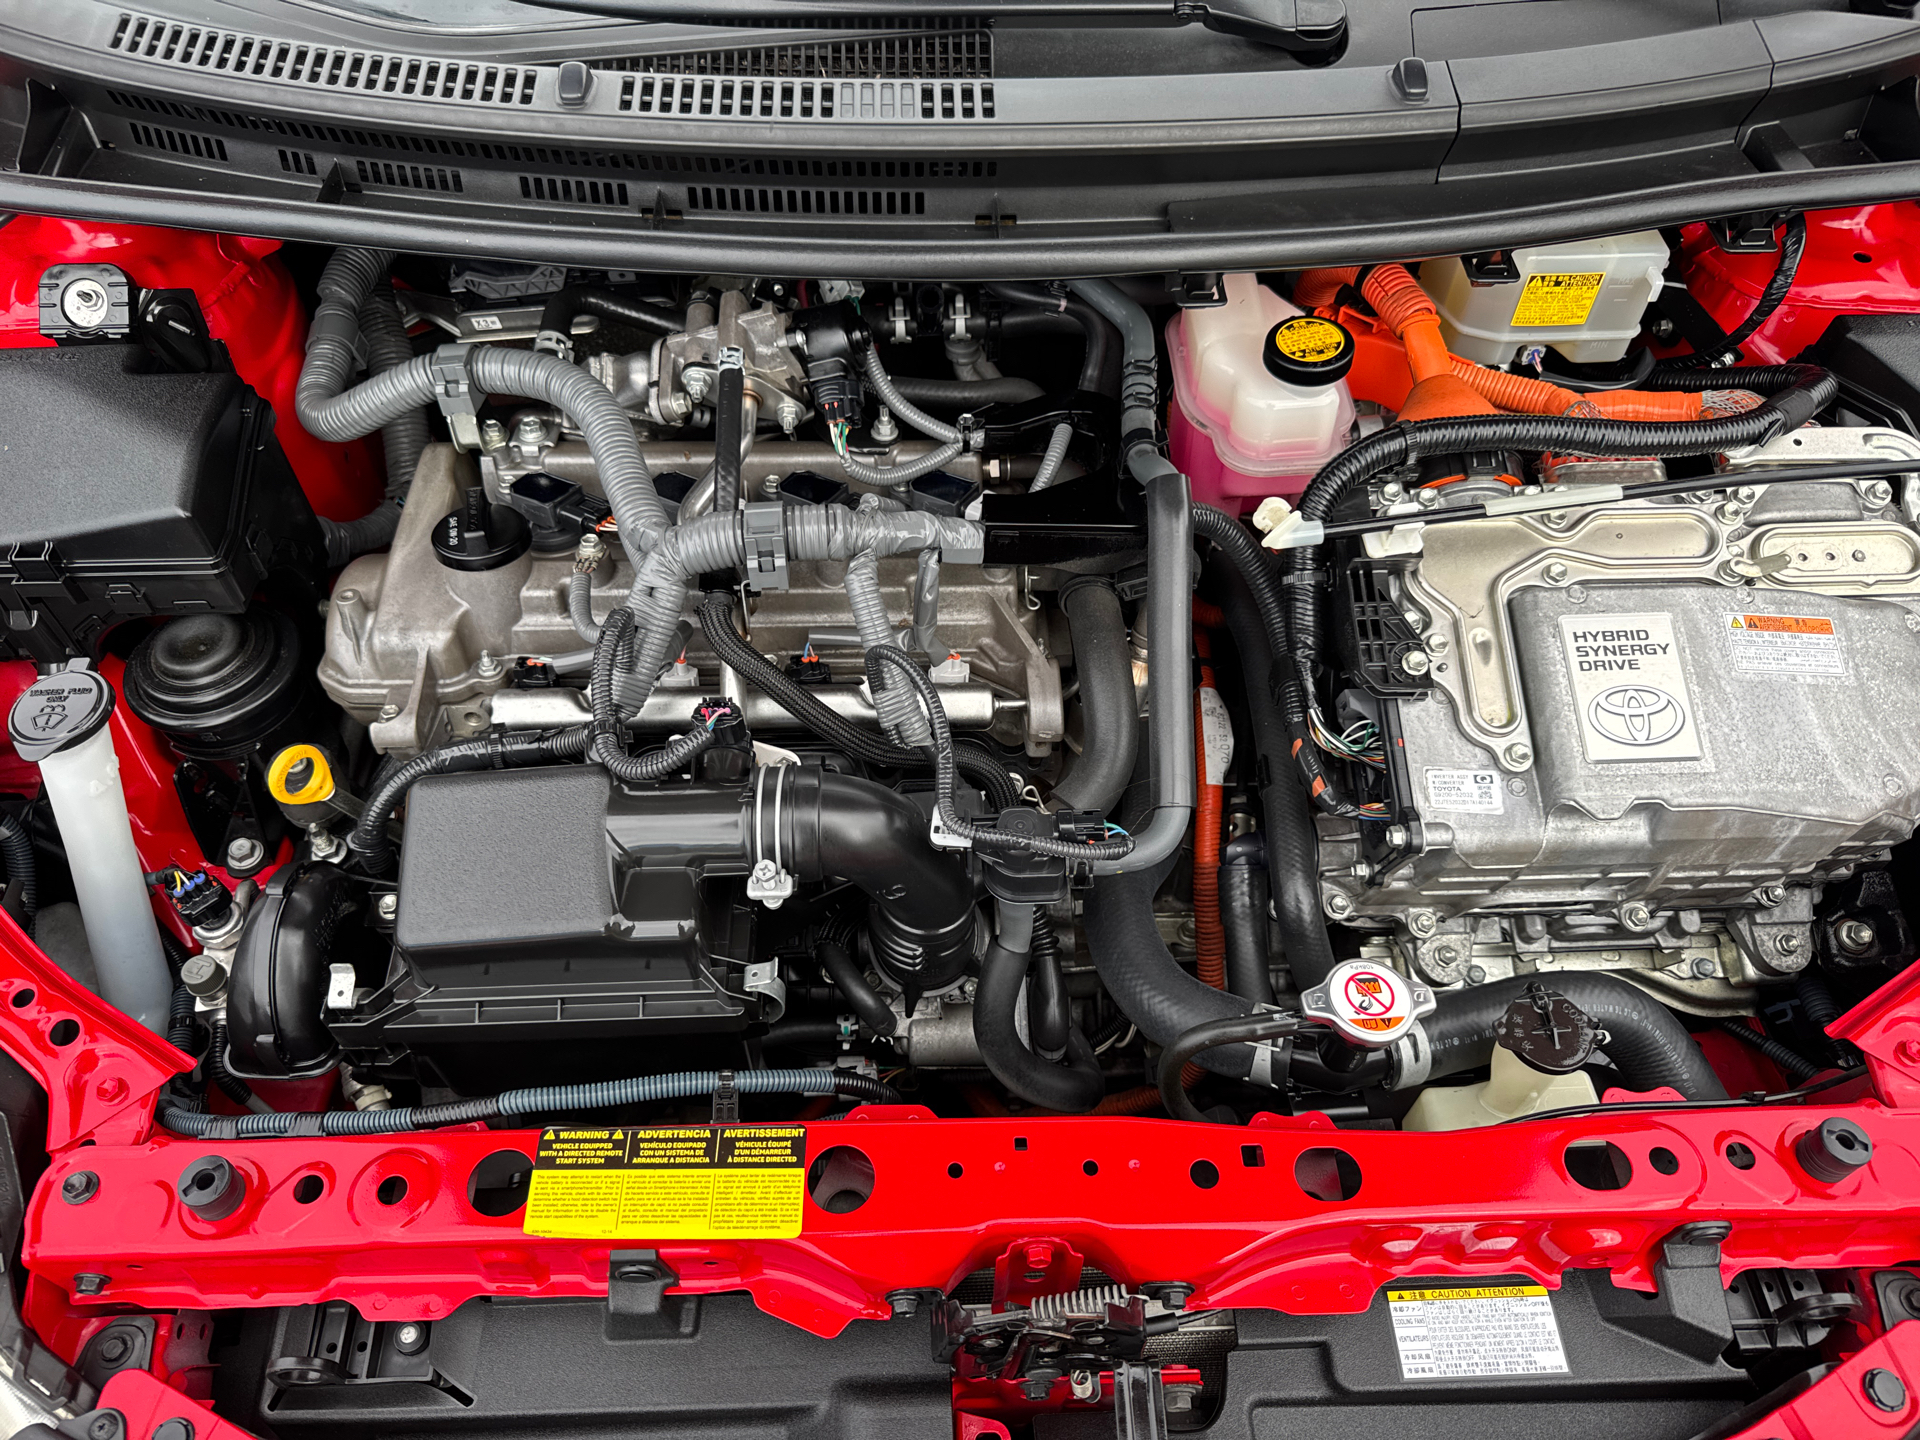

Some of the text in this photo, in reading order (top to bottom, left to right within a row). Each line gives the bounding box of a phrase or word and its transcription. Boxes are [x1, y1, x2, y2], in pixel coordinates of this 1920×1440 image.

[449, 517, 458, 528] SAE
[1573, 630, 1649, 642] HYBRID
[1576, 643, 1670, 657] SYNERGY
[1579, 659, 1640, 671] DRIVE
[30, 688, 65, 696] WASHER
[1221, 744, 1230, 764] 070
[1593, 1004, 1613, 1013] WATER
[1562, 1003, 1588, 1054] COOLANT
[1664, 1044, 1678, 1060] WATER
[560, 1131, 609, 1139] WARNING
[638, 1130, 711, 1138] ADVERTENCIA
[724, 1129, 805, 1138] AVERTISSEMENT
[1410, 1288, 1525, 1299] 注意 CAUTION ATTENTION
